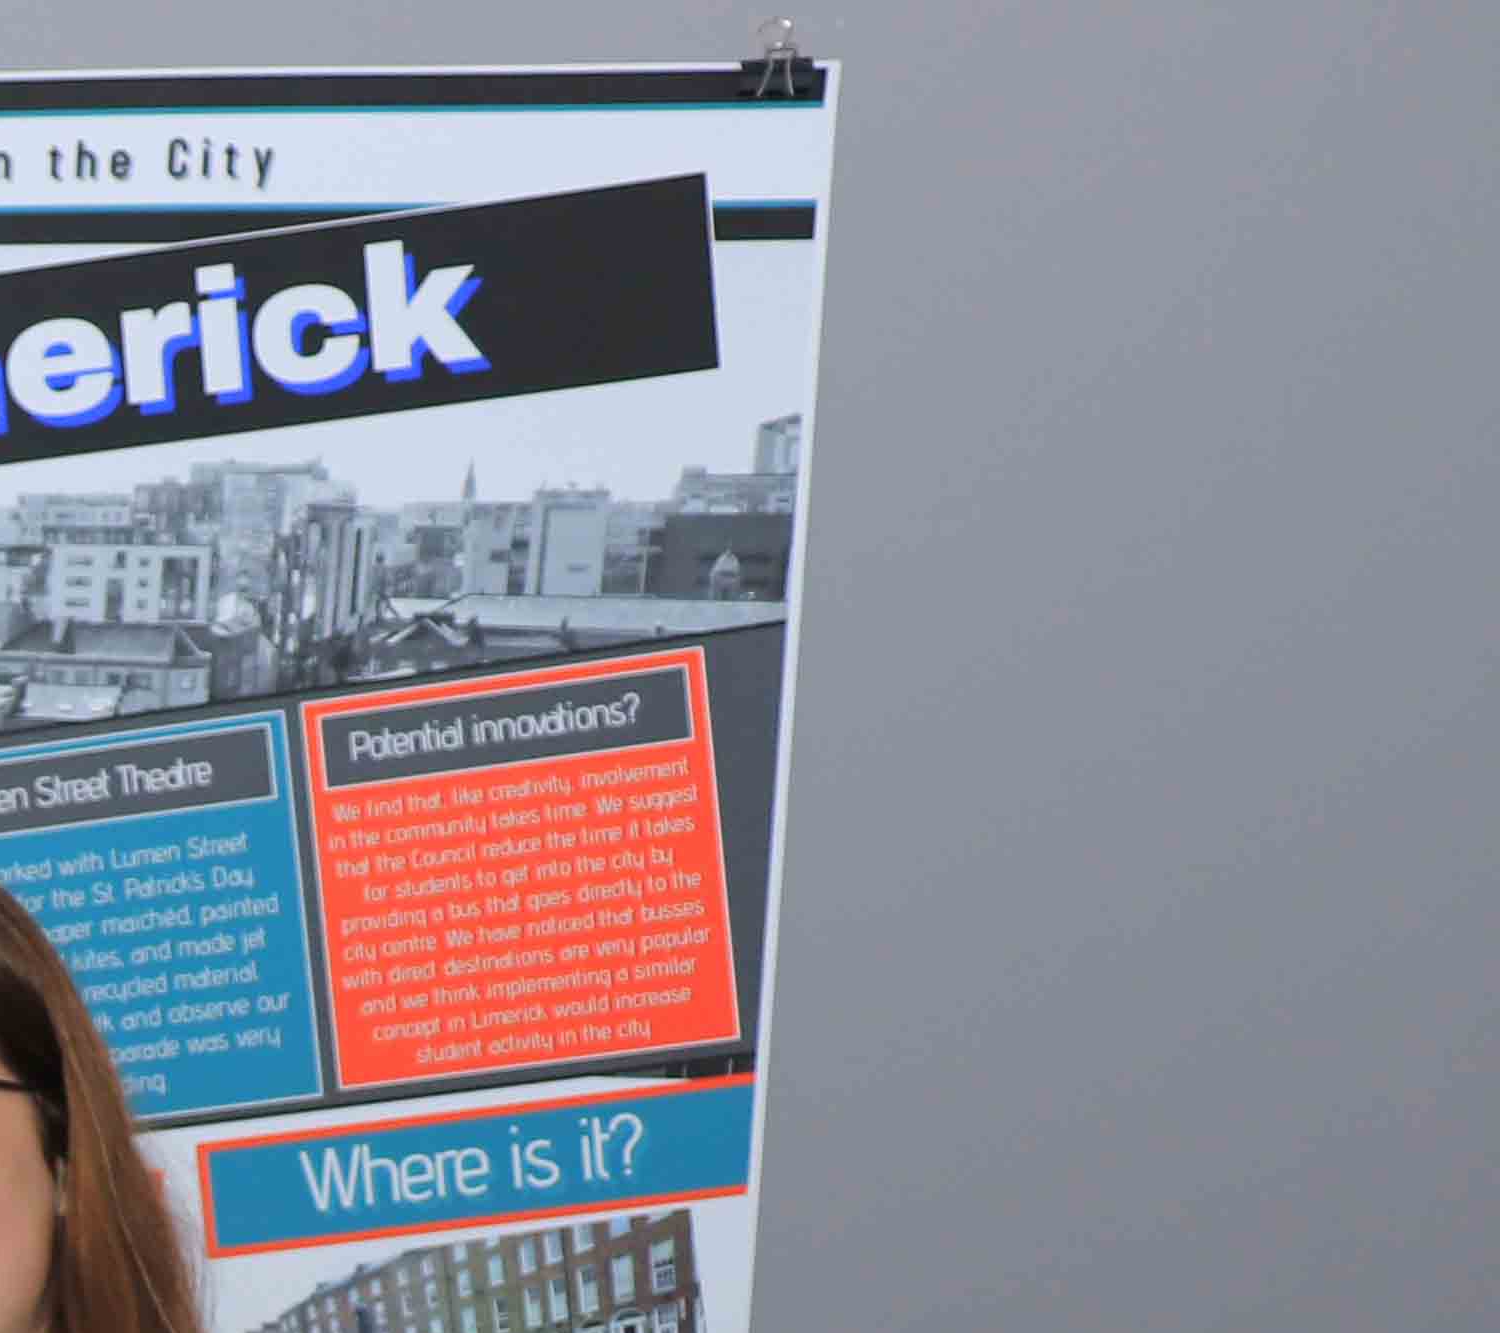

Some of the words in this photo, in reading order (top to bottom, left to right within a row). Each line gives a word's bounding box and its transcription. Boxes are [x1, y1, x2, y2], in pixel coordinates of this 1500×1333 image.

[45, 138, 135, 181] the
[166, 138, 277, 187] City
[348, 718, 464, 762] Potential
[471, 691, 640, 741] innovations?
[34, 767, 111, 809] Street
[117, 757, 214, 795] Theatre
[333, 802, 360, 822] We
[366, 796, 402, 817] find
[452, 786, 484, 805] like
[580, 757, 688, 789] involvement
[330, 836, 346, 849] in
[349, 830, 380, 846] the
[385, 815, 486, 843] community
[491, 807, 540, 828] takes
[595, 794, 622, 815] We
[629, 784, 698, 810] suggest
[59, 852, 104, 877] with
[111, 845, 181, 870] Lumen
[187, 832, 248, 860] Street
[336, 860, 369, 878] that
[376, 853, 405, 873] the
[410, 841, 476, 868] Council
[482, 836, 540, 858] reduce
[545, 833, 575, 850] the
[581, 826, 622, 846] time
[646, 817, 694, 836] takes
[364, 885, 386, 902] for
[395, 872, 472, 900] students
[477, 869, 496, 888] to
[503, 865, 529, 888] get
[536, 860, 571, 877] into
[577, 855, 605, 873] the
[612, 852, 644, 870] city
[652, 847, 673, 865] by
[52, 888, 85, 909] the
[124, 871, 205, 900] Patrick's
[342, 908, 427, 937] providing
[432, 907, 443, 921] a
[448, 900, 481, 919] bus
[486, 895, 520, 913] that
[527, 891, 572, 912] goes
[577, 881, 643, 904] directly
[648, 875, 667, 892] to
[672, 870, 701, 888] the
[49, 920, 92, 945] aper
[201, 892, 279, 926] painted
[344, 942, 376, 963] city
[445, 927, 473, 948] We
[477, 924, 522, 945] have
[528, 912, 595, 937] noticed
[599, 908, 636, 926] that
[640, 899, 706, 921] busses
[130, 942, 172, 966] and
[179, 932, 235, 957] made
[243, 928, 266, 954] jet
[342, 971, 382, 990] with
[389, 963, 436, 985] direct
[444, 951, 556, 977] destinations
[560, 943, 588, 961] are
[595, 937, 635, 958] very
[640, 926, 710, 955] popular
[84, 975, 169, 1005] recycled
[120, 1007, 162, 1030] and
[167, 995, 251, 1024] observe
[257, 993, 290, 1015] our
[361, 997, 396, 1016] and
[402, 993, 429, 1008] we
[432, 984, 480, 1007] think
[486, 967, 612, 1001] implementing
[635, 958, 696, 980] similar
[373, 1017, 442, 1041] concept
[448, 1014, 465, 1032] in
[471, 1003, 547, 1030] Limerick
[555, 995, 610, 1017] would
[615, 985, 692, 1009] increase
[109, 1038, 181, 1065] parade
[187, 1032, 228, 1053] was
[237, 1026, 283, 1049] very
[416, 1040, 482, 1064] student
[489, 1032, 554, 1054] activity
[559, 1028, 577, 1046] in
[581, 1022, 611, 1041] the
[300, 1141, 489, 1214] Where
[508, 1125, 560, 1190] is
[578, 1111, 645, 1183] it?
